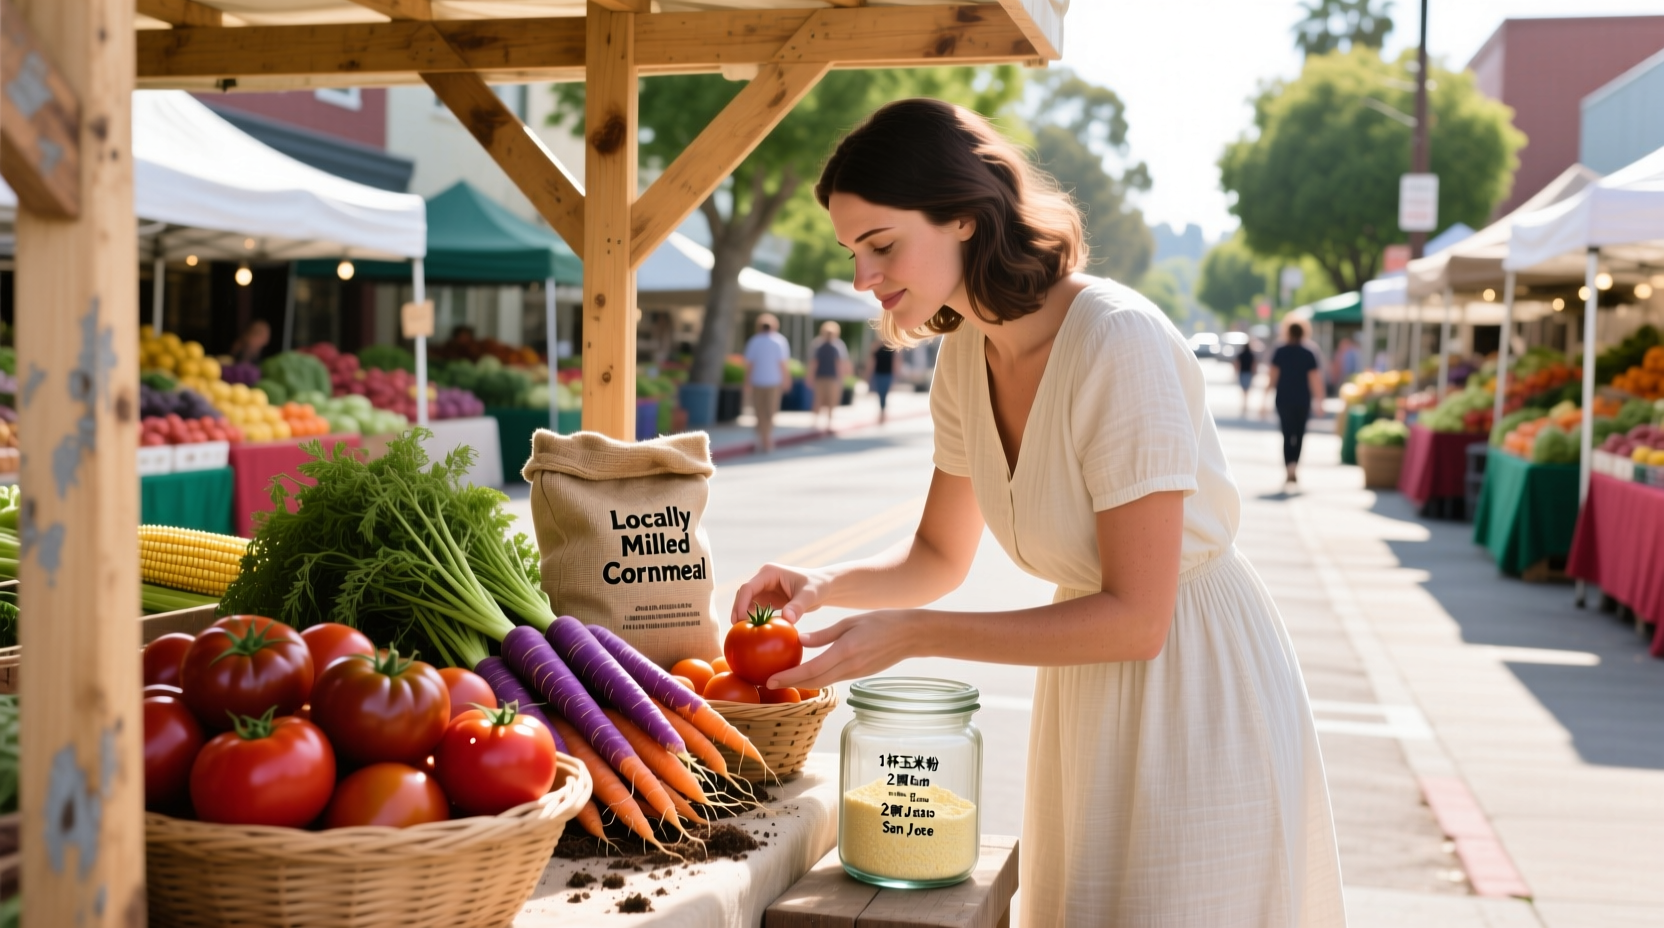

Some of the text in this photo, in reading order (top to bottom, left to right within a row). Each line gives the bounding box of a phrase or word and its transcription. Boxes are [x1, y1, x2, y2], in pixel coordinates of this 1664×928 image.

[609, 506, 691, 532] Locally
[621, 532, 690, 557] Milled
[602, 557, 706, 585] Cornmeal
[882, 820, 903, 835] San
